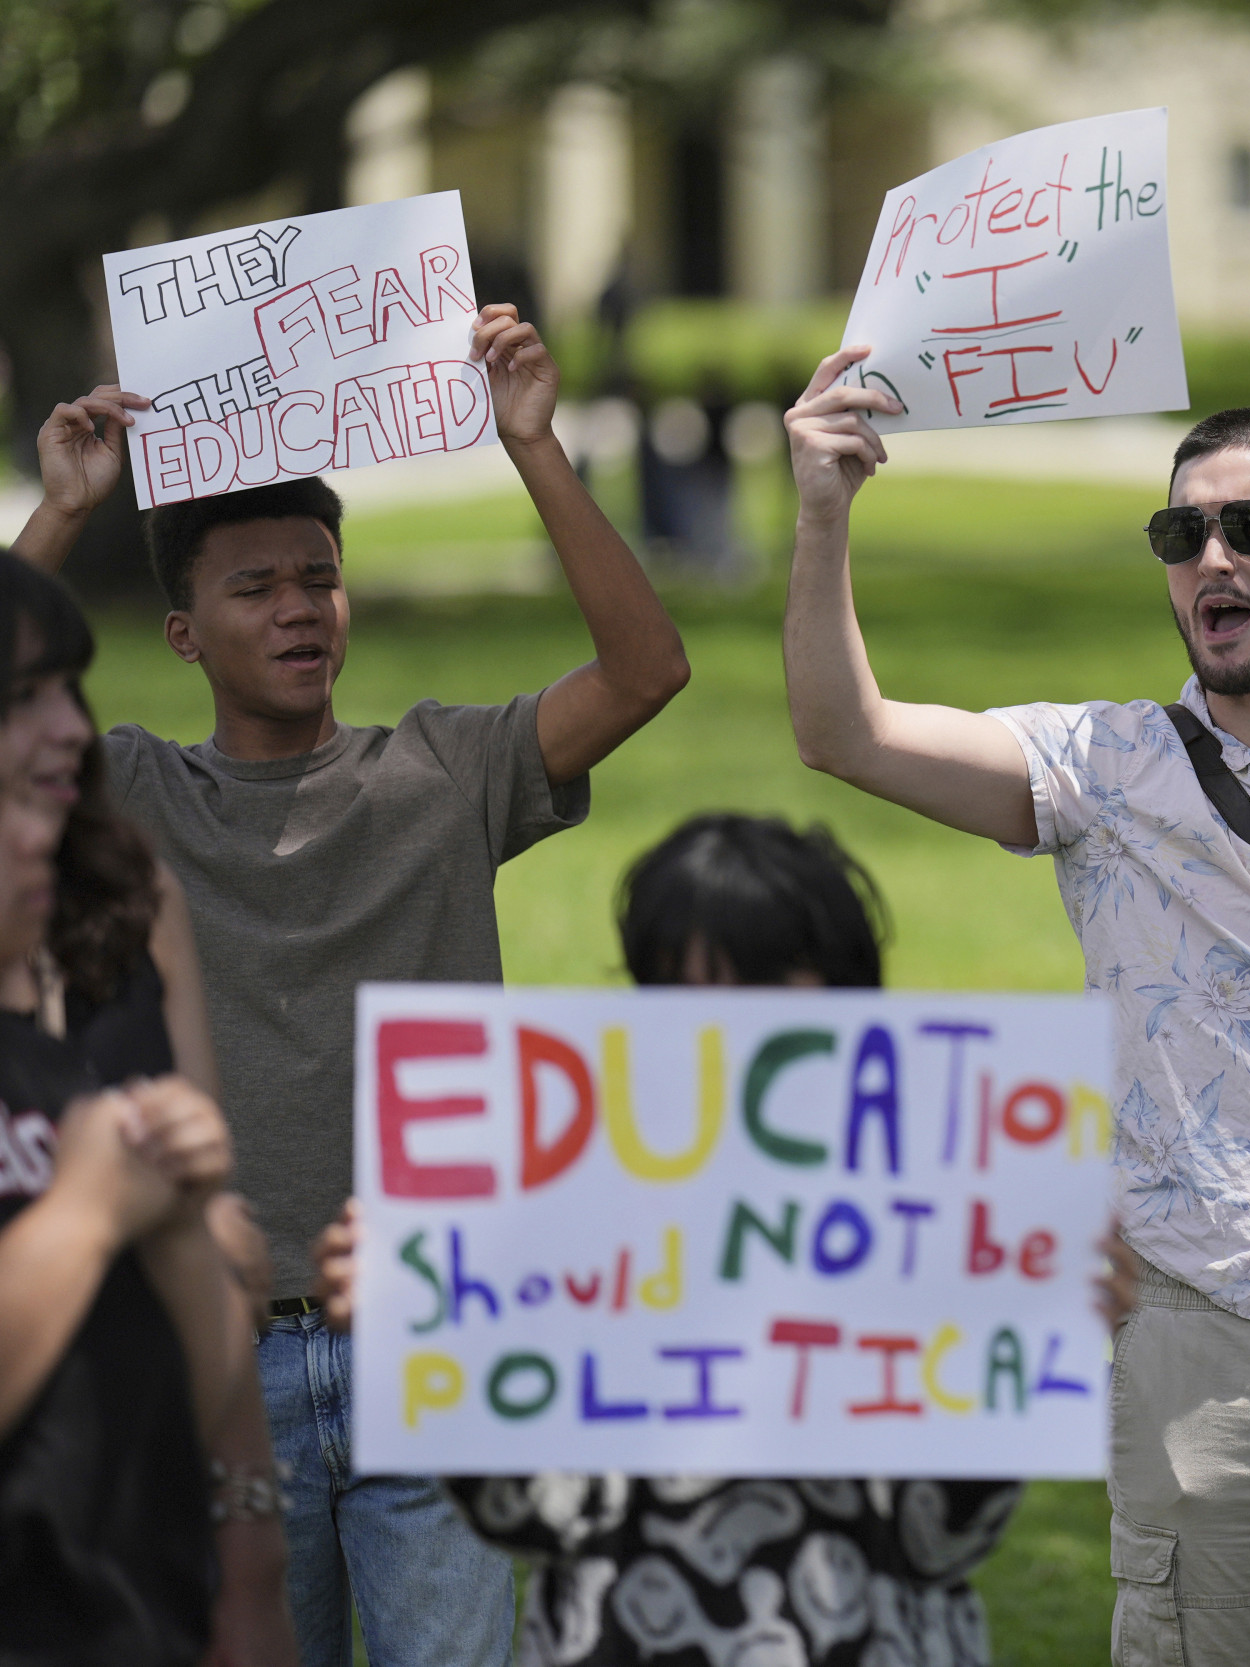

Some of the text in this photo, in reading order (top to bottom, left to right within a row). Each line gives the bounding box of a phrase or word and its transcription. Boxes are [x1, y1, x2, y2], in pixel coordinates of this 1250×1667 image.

[118, 224, 302, 325] THEY
[874, 146, 1164, 286] Protect the
[253, 244, 477, 380] FEAR
[139, 359, 491, 508] EDUCATED
[151, 354, 283, 428] THE
[717, 1197, 936, 1284] NOT
[964, 1197, 1061, 1281] be
